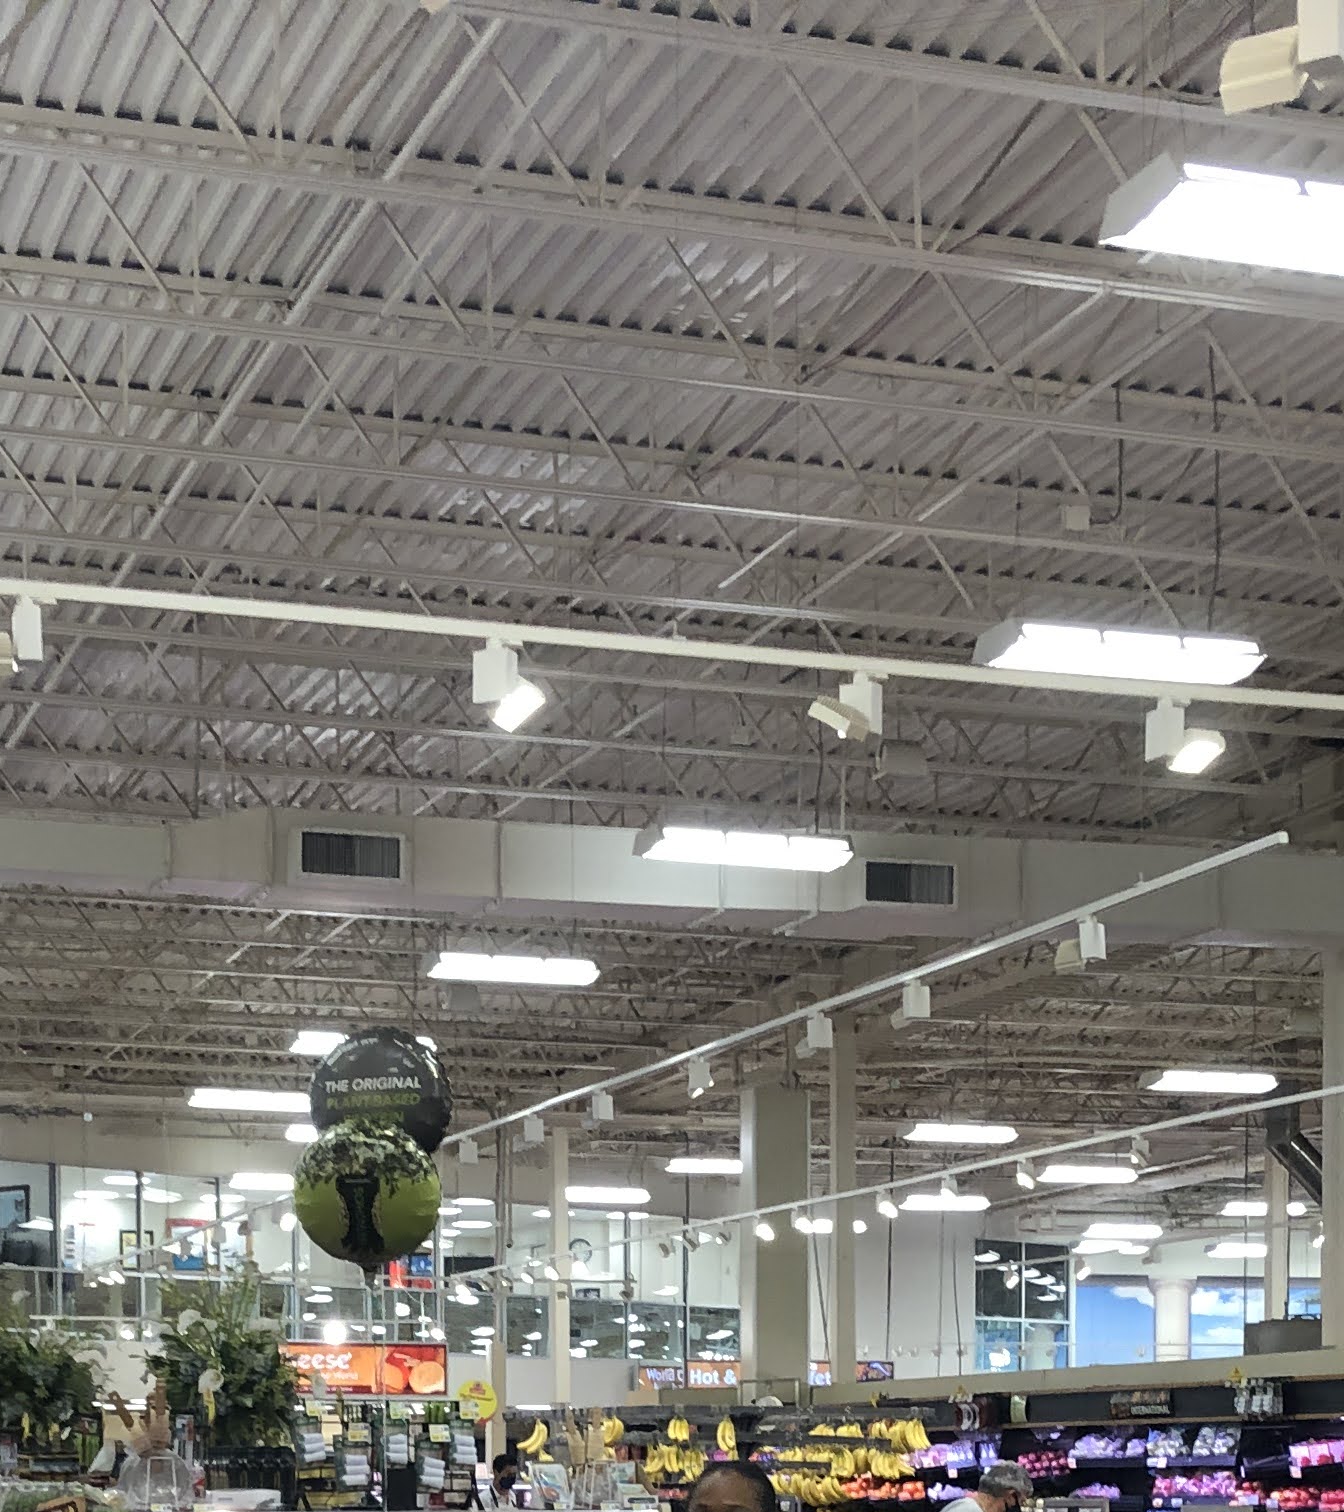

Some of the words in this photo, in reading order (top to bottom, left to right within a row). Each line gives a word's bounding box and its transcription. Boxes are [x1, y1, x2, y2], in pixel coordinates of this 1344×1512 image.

[325, 1079, 349, 1093] THE
[352, 1076, 421, 1091] ORIGINAL
[690, 1369, 720, 1386] Hot
[723, 1369, 737, 1385] &
